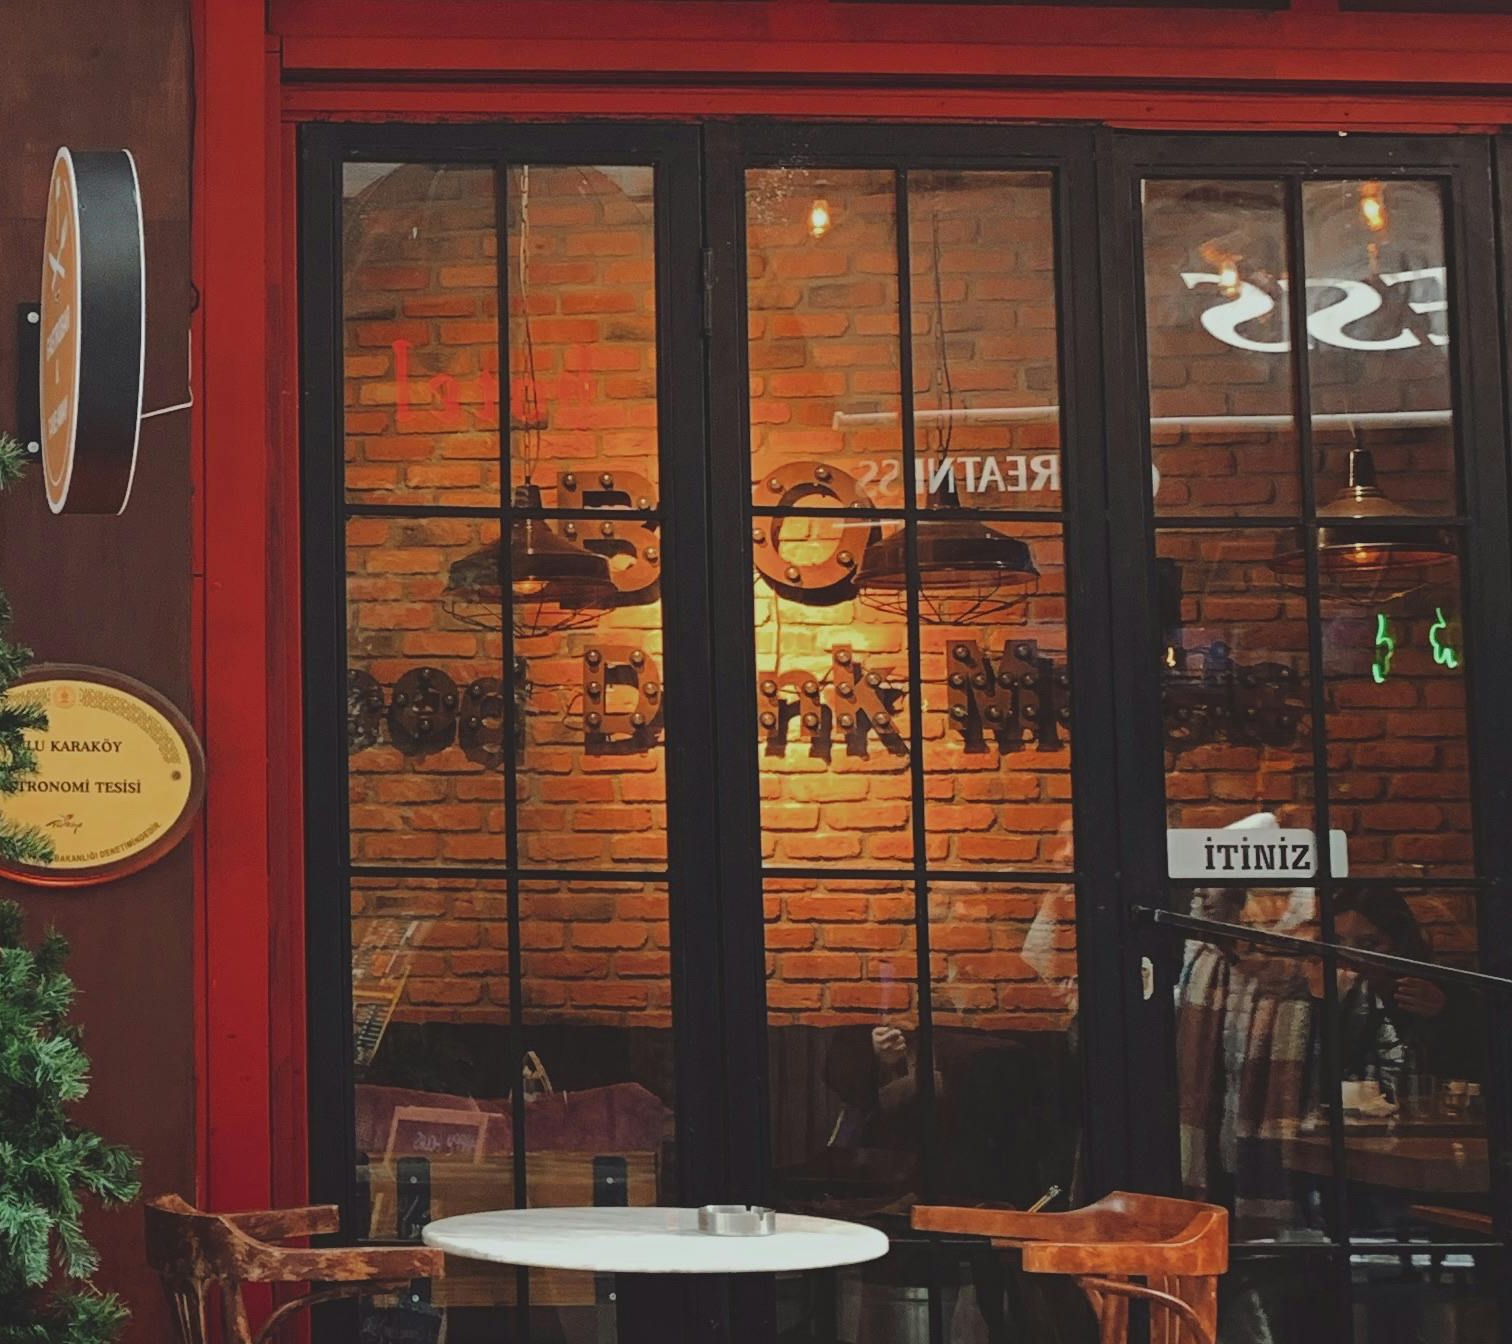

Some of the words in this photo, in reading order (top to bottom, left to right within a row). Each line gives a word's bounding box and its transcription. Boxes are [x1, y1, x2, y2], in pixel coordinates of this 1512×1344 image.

[50, 738, 123, 753] KARAKÖY
[95, 779, 142, 794] TESİSİ
[1204, 836, 1311, 871] İTİNİZ
